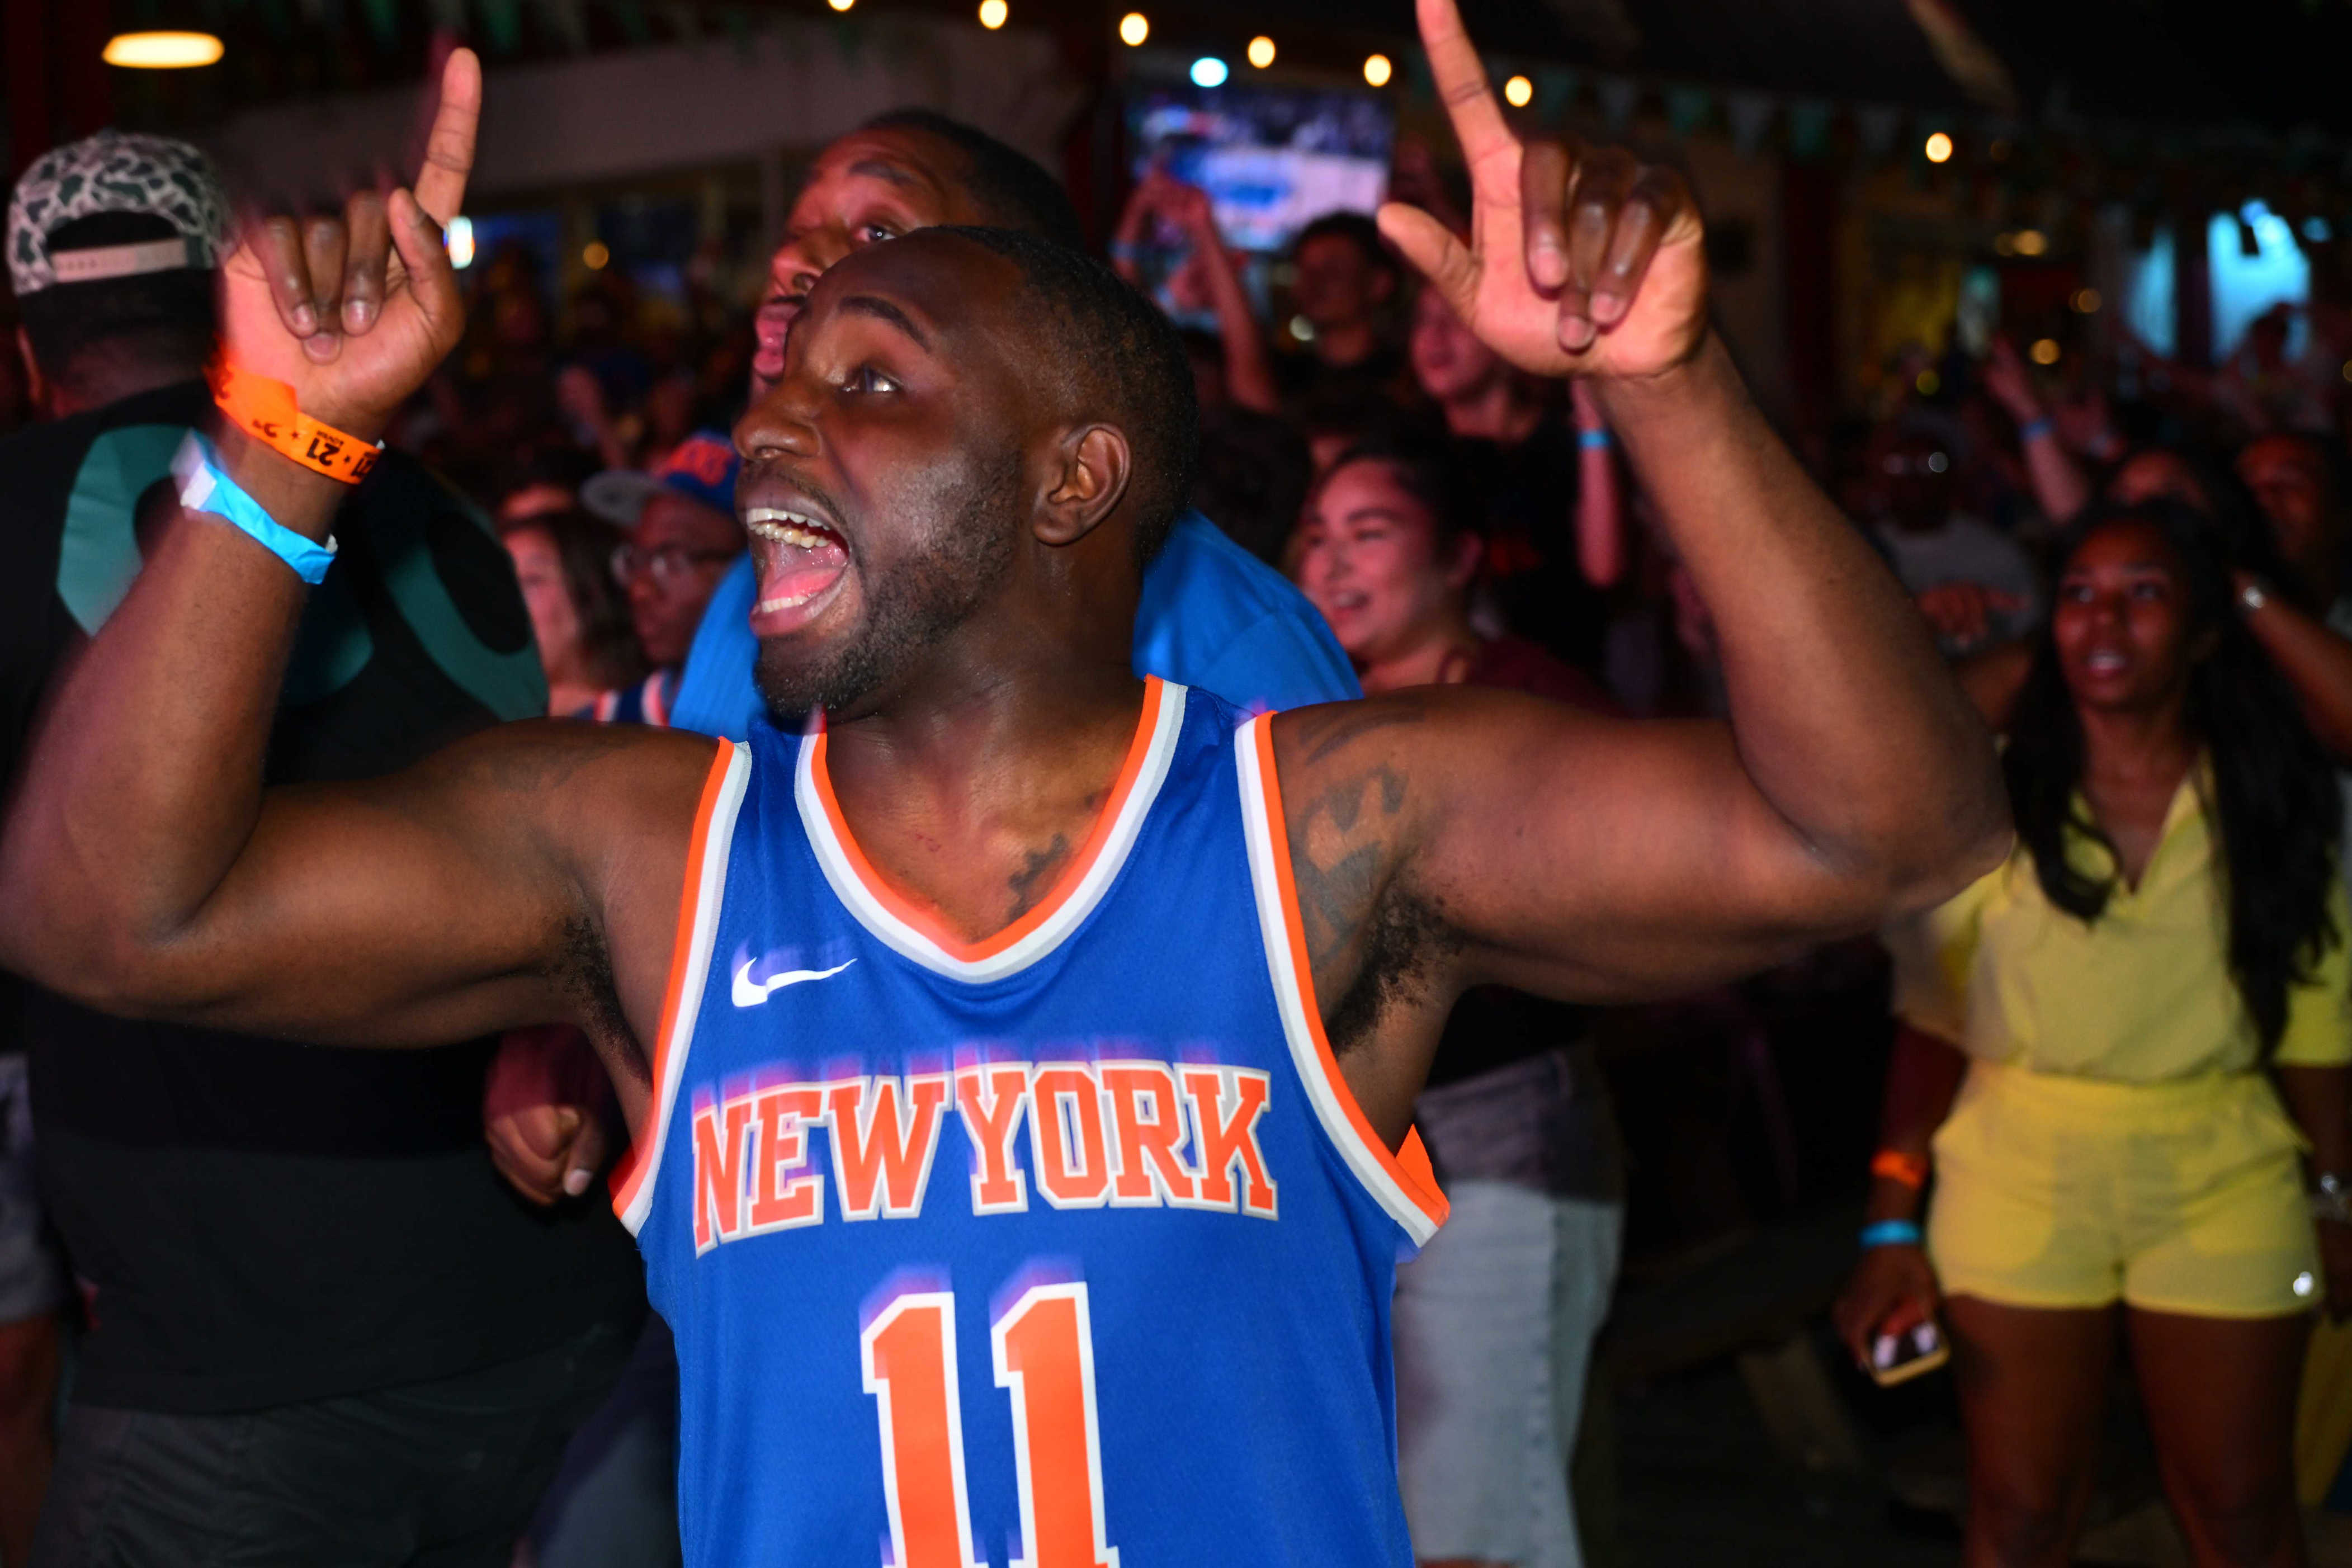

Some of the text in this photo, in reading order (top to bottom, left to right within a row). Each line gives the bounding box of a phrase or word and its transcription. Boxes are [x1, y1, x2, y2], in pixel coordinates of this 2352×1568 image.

[306, 437, 339, 466] 21
[693, 1060, 1279, 1259] NEW YORK
[859, 1281, 1121, 1568] 11
